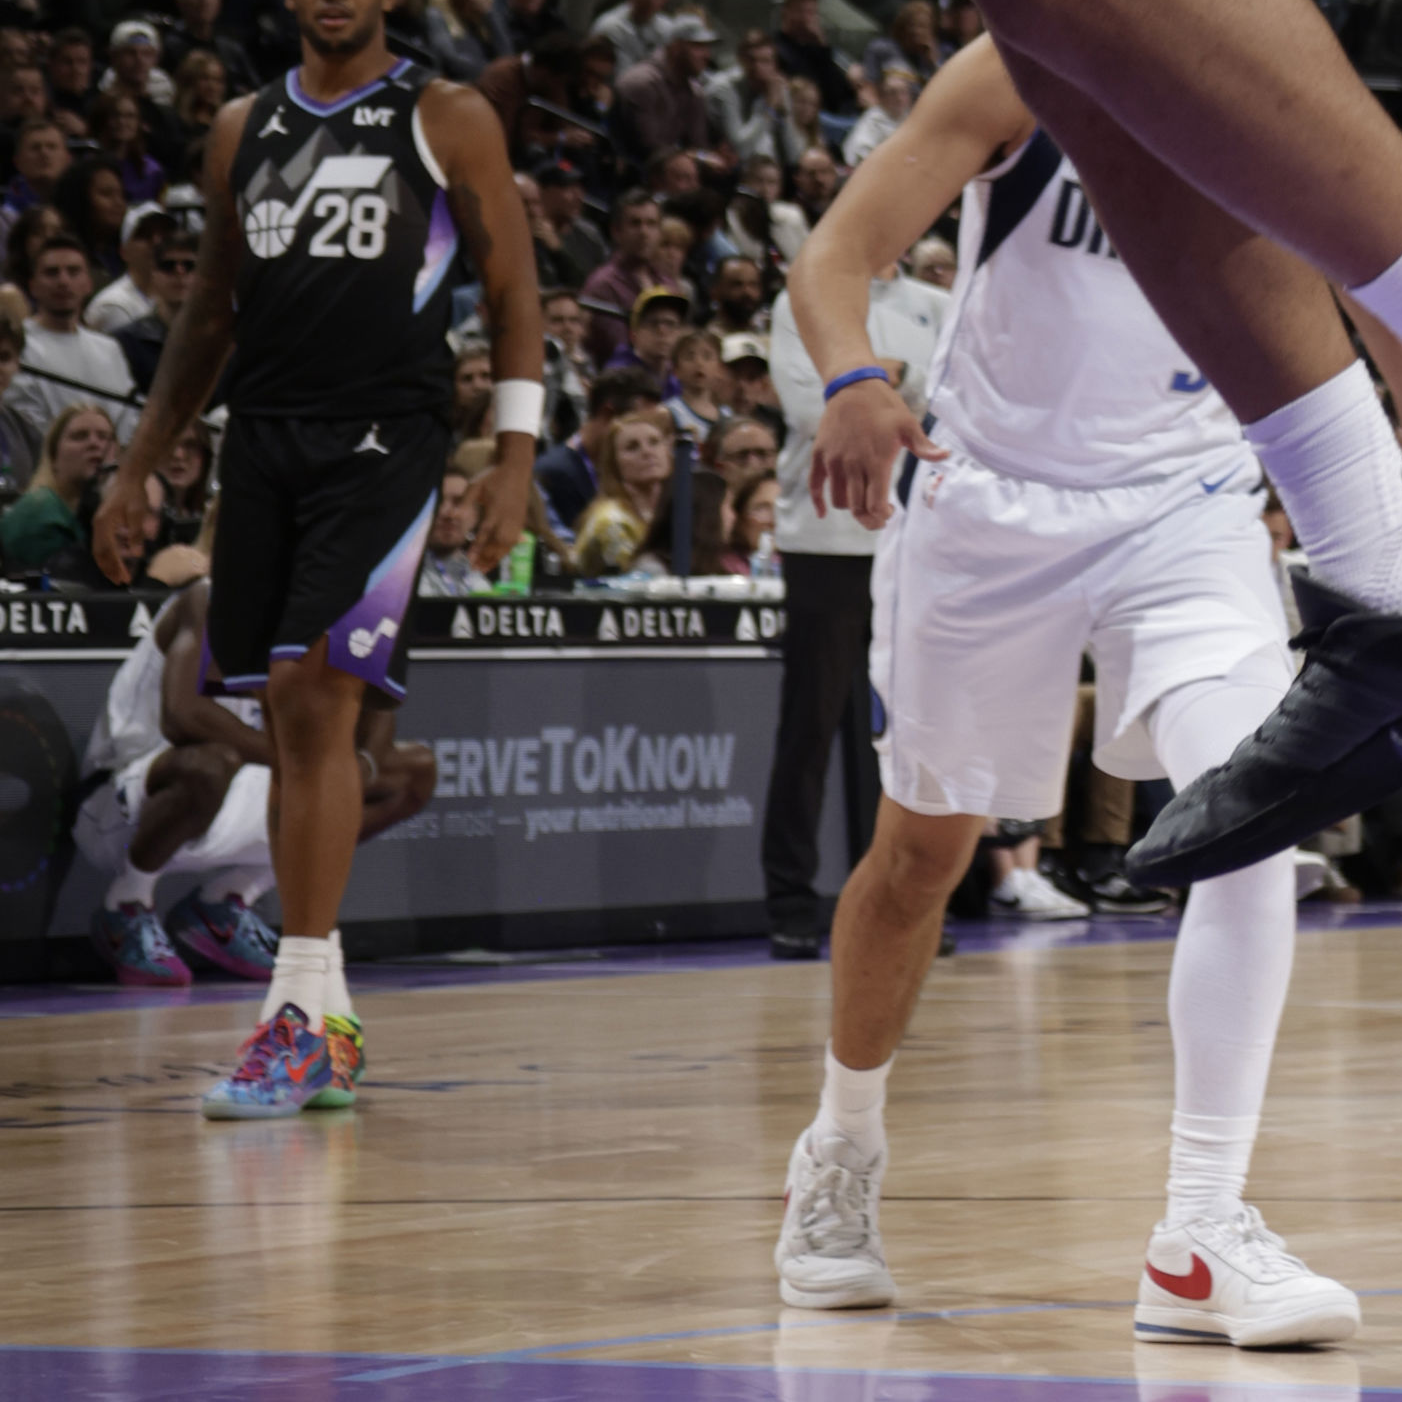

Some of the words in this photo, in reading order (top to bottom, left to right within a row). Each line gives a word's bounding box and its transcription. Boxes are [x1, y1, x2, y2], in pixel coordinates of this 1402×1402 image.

[307, 193, 390, 260] 28
[477, 604, 565, 637] DELTA
[622, 606, 706, 638] DELTA
